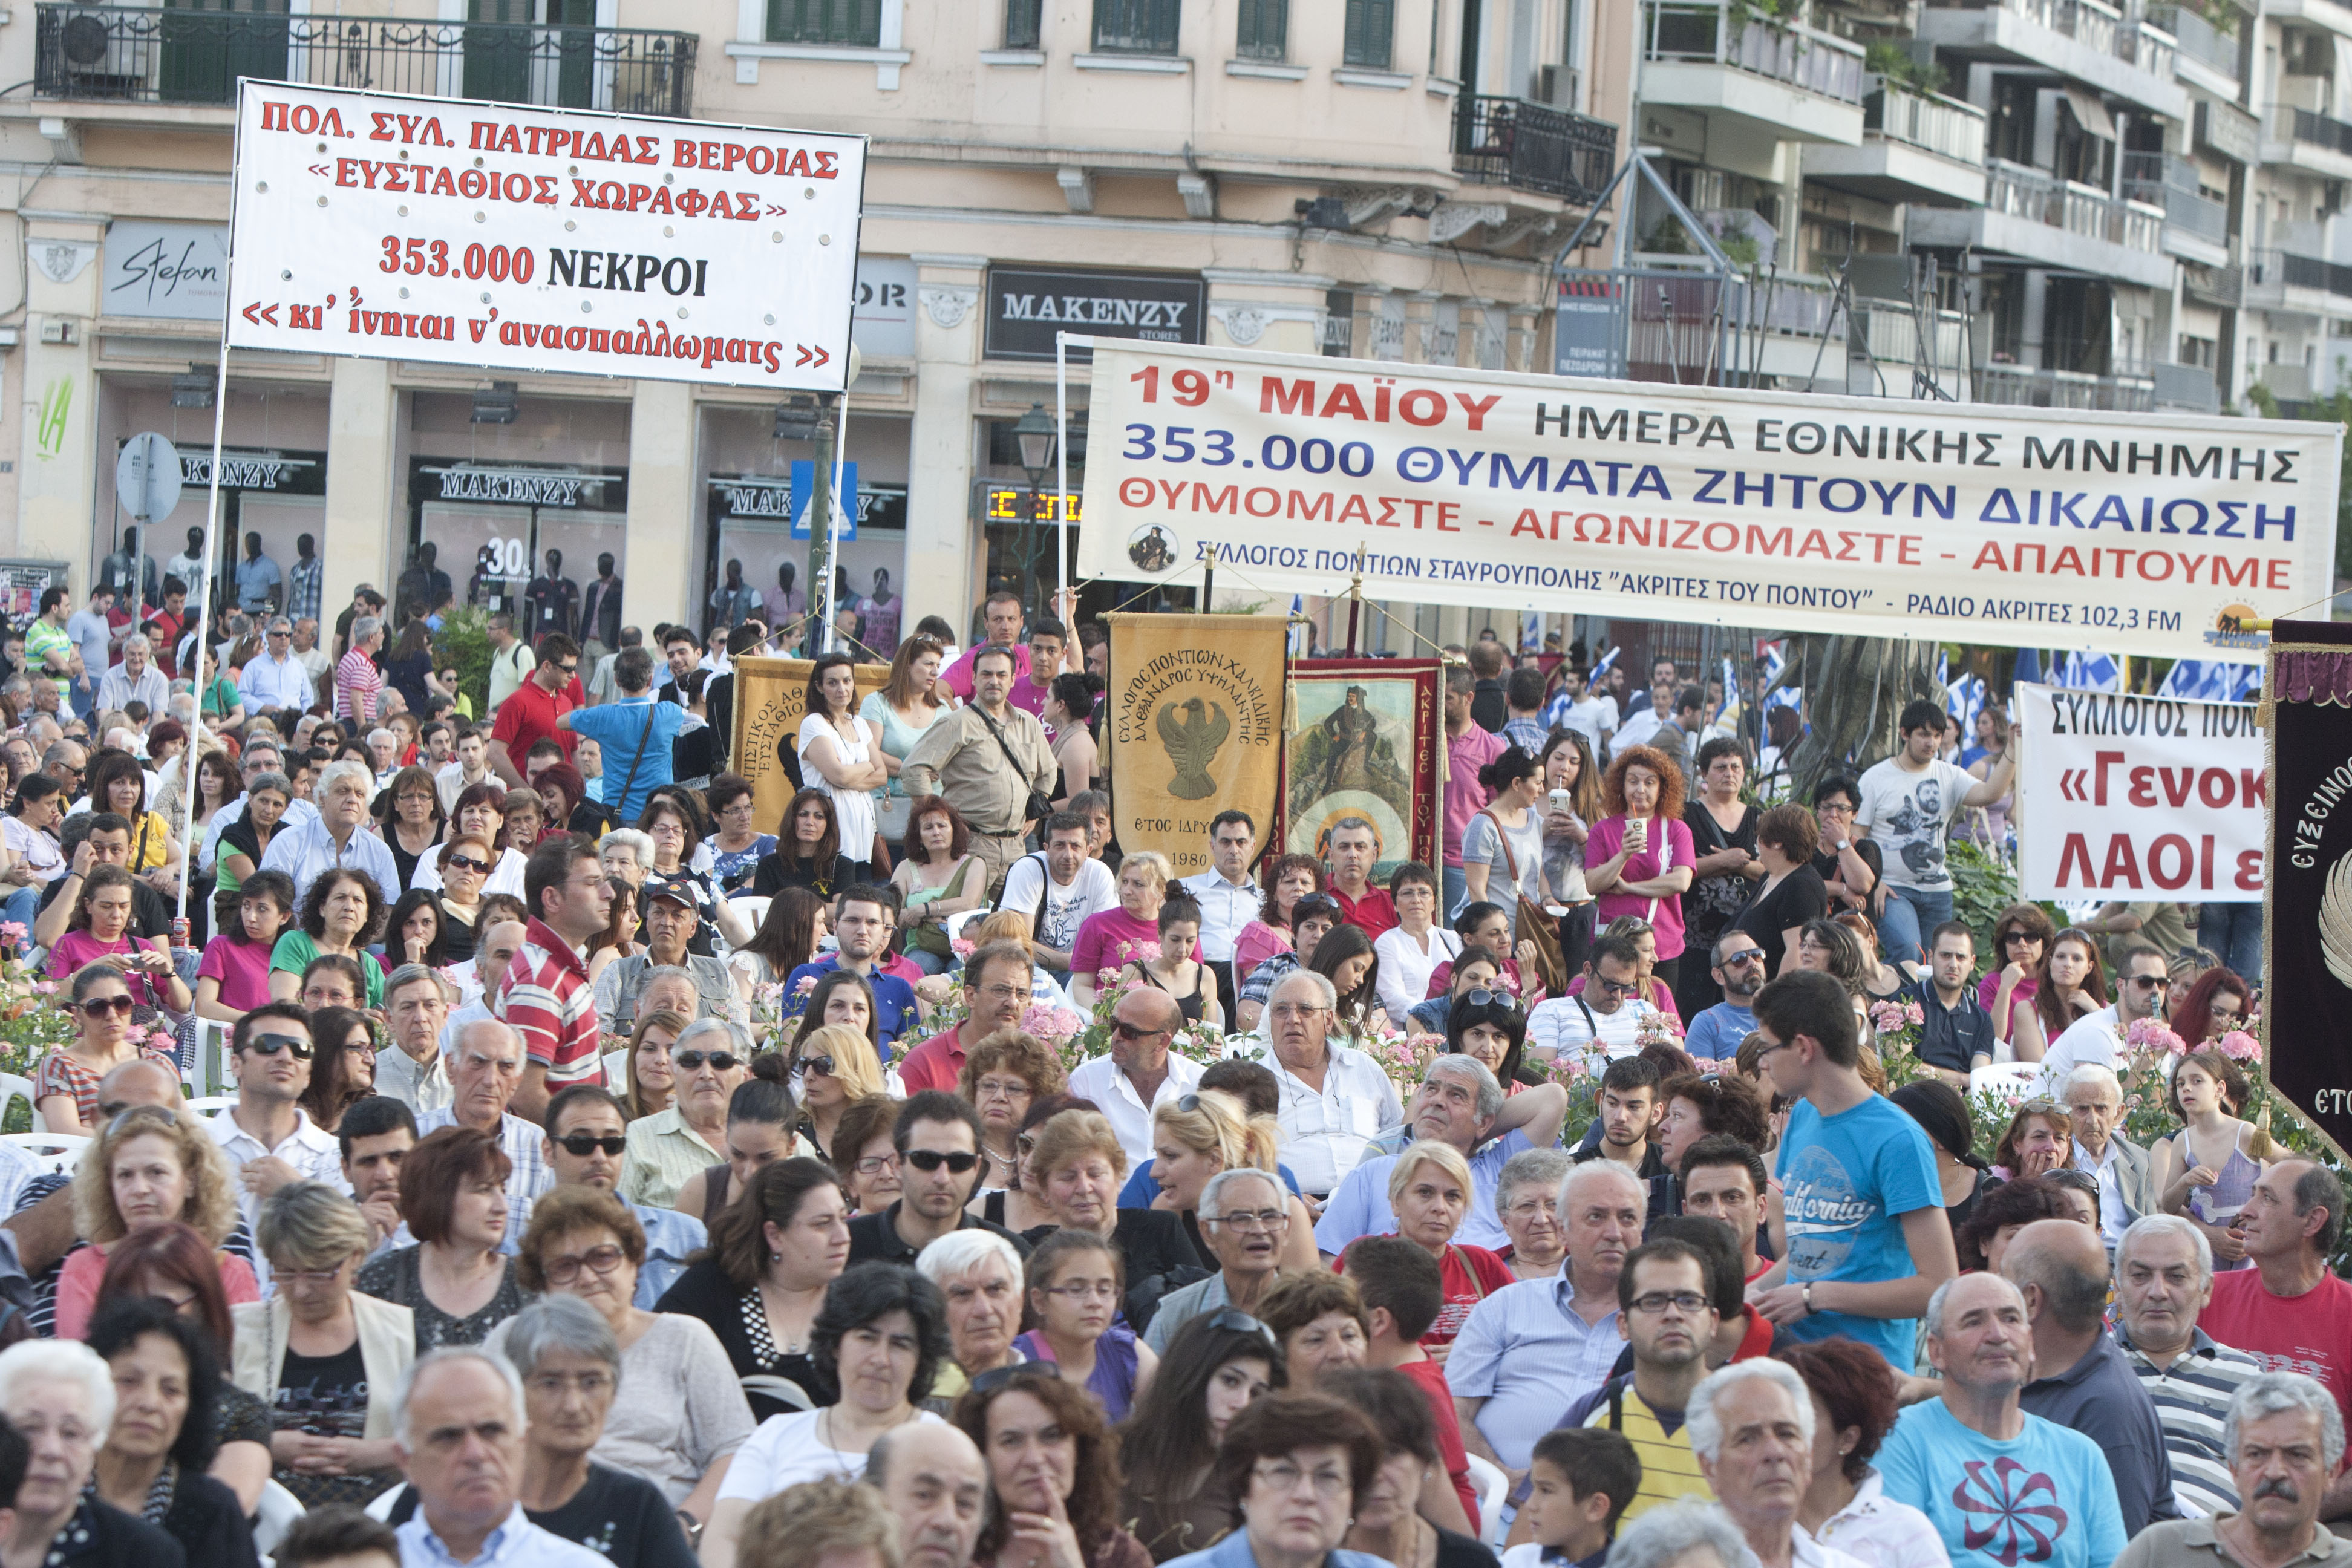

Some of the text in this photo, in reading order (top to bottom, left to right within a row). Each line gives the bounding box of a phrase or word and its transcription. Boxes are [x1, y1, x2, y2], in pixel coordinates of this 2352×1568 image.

[260, 102, 838, 178] ΠΟΛ. ΣΥΛ. ΠΑΤΡΙΔΑΣ ΒΕΡΟΙΑΣ
[111, 237, 217, 307] Stefan
[379, 235, 708, 297] 353.000 ΝΕΚΡΟΙ
[1002, 293, 1187, 328] MAKENZY
[1139, 330, 1181, 342] STORES
[1259, 376, 1501, 431] ΜΑΪΟΥ
[1535, 403, 1734, 449] ΗΜΕΡΑ
[1756, 419, 2002, 467] ΕΘΝΙΚΗΣ
[2022, 436, 2300, 483] ΜΝΗΜΗΣ
[181, 458, 281, 489] KENZY
[440, 472, 581, 506] MAKENZY
[1122, 423, 2296, 541] 353.000 ΘΥΜΑΤΑ ΖΗΤΟΥΝ ΔΙΚΑΙΩΣΗ
[1119, 477, 1460, 532] ΘΥΜΟΜΑΣΤΕ
[1510, 508, 1921, 565] ΑΓΩΝΙΖΟΜΑΣΤΕ
[1972, 540, 2291, 589] ΑΠΑΙΤΟΥΜΕ
[1195, 540, 1307, 569] ΣΥΛΛΟΓΟΣ
[1315, 550, 1420, 577] ΠΟΝΤΙΩΝ
[1428, 559, 1602, 591] ΣΤΑΥΡΟΥΠΟΛΗΣ
[1716, 580, 1759, 602] ΤΟΥ
[1907, 594, 1975, 617] ΡΑΔΙΟ
[1981, 599, 2072, 624] ΑΚΡΙΤΕΣ
[2080, 606, 2138, 632] 102,3
[2148, 610, 2181, 631] FM
[2051, 693, 2189, 738] ΣΥΛΛΟΓΟΣ
[1171, 852, 1207, 867] 1980
[2054, 832, 2215, 891] ΛΑΟΙ
